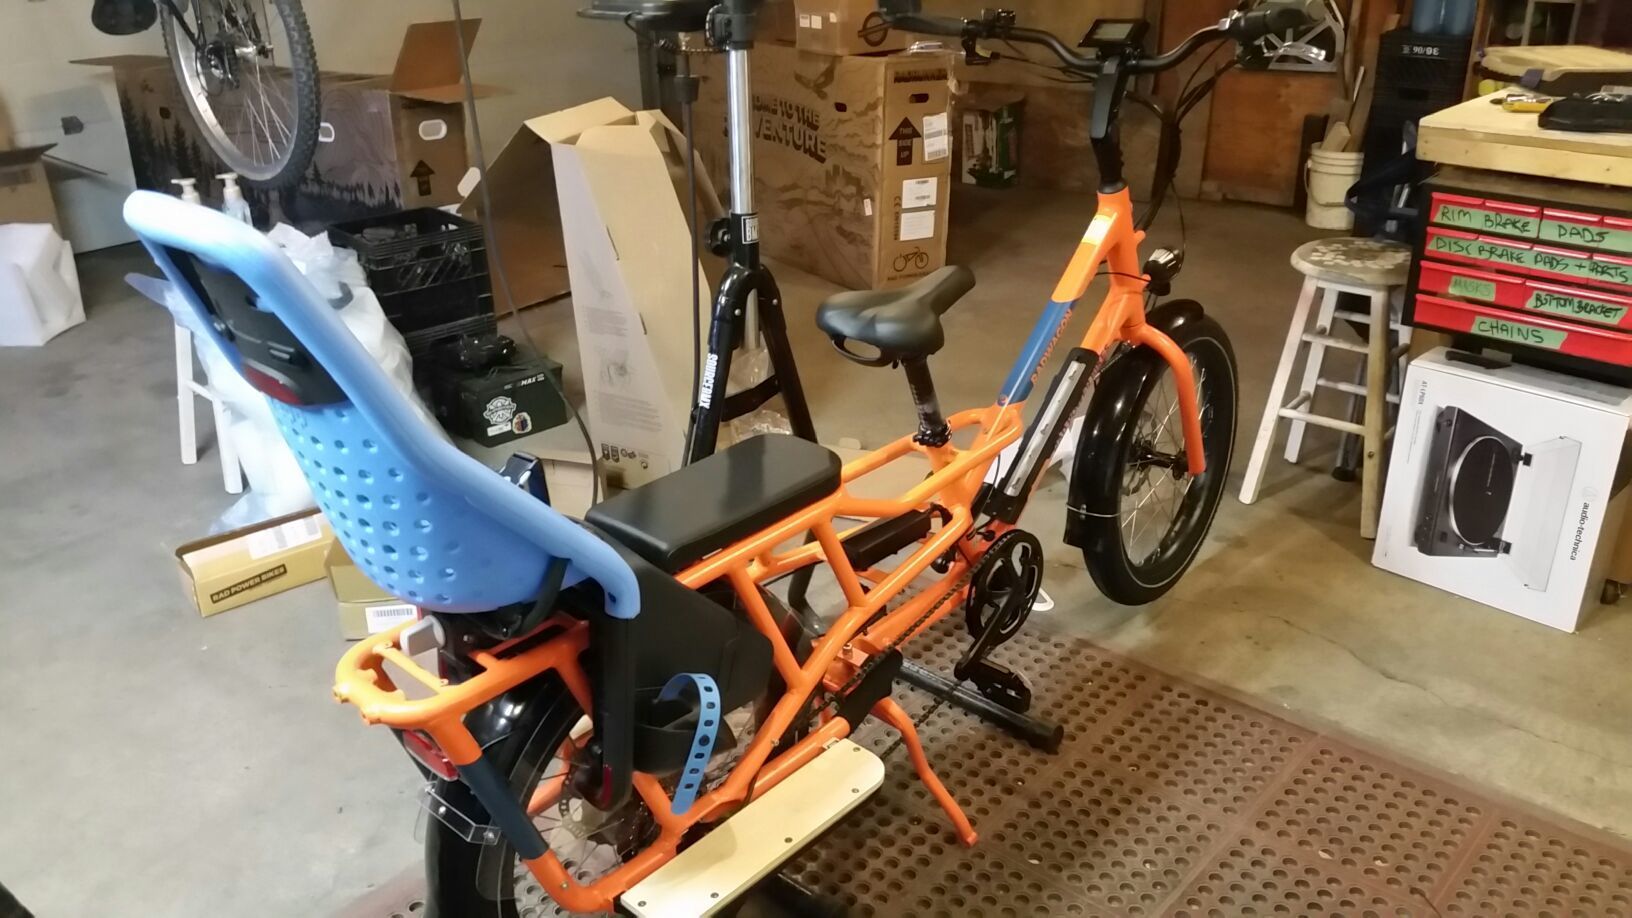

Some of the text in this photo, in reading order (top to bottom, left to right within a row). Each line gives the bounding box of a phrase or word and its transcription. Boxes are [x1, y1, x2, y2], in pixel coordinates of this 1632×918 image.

[780, 100, 794, 119] TO
[796, 105, 820, 131] THE
[722, 113, 827, 164] VENTURE
[1441, 206, 1610, 243] RIM BRAKE PADS
[1436, 237, 1472, 256] DISC
[1479, 246, 1525, 263] BRAKE
[1535, 253, 1569, 272] PADS
[1534, 293, 1623, 318] BOTTOM BRACKET
[1477, 321, 1544, 344] CHAINS
[1569, 502, 1590, 561] audio-technica
[231, 576, 261, 594] POWER
[261, 566, 285, 581] BIKES
